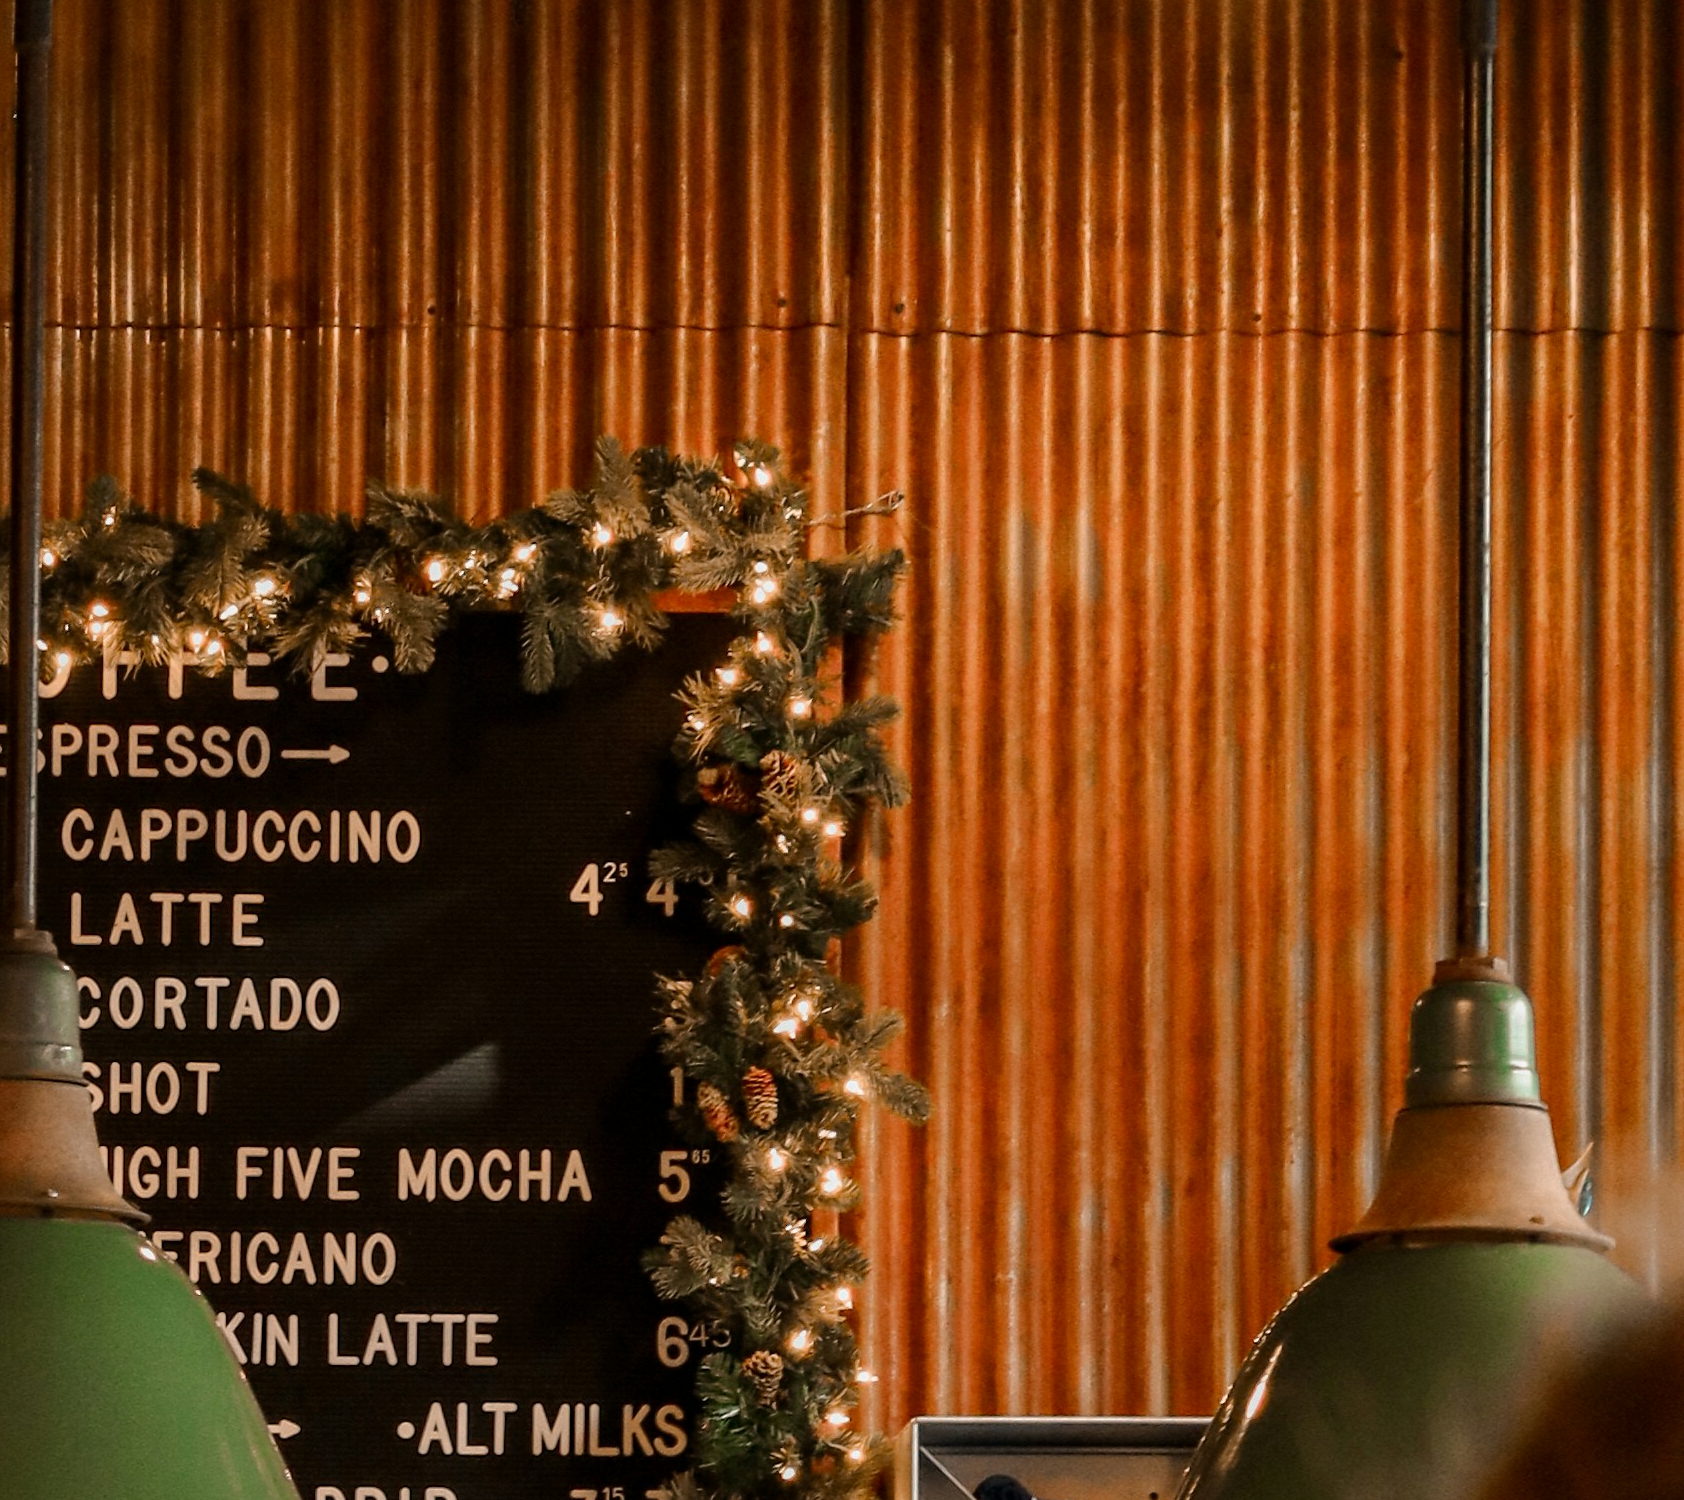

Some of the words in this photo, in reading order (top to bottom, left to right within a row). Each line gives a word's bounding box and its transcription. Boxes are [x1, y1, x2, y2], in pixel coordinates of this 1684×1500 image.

[62, 808, 420, 863] CAPPUCCINO
[71, 892, 264, 946] LATTE
[74, 979, 340, 1032] CORTADO
[237, 1147, 360, 1200] FIVE
[398, 1148, 592, 1202] MOCHA
[143, 1231, 396, 1286] ERICANO
[328, 1313, 498, 1366] LATTE
[533, 1403, 686, 1456] MILKS
